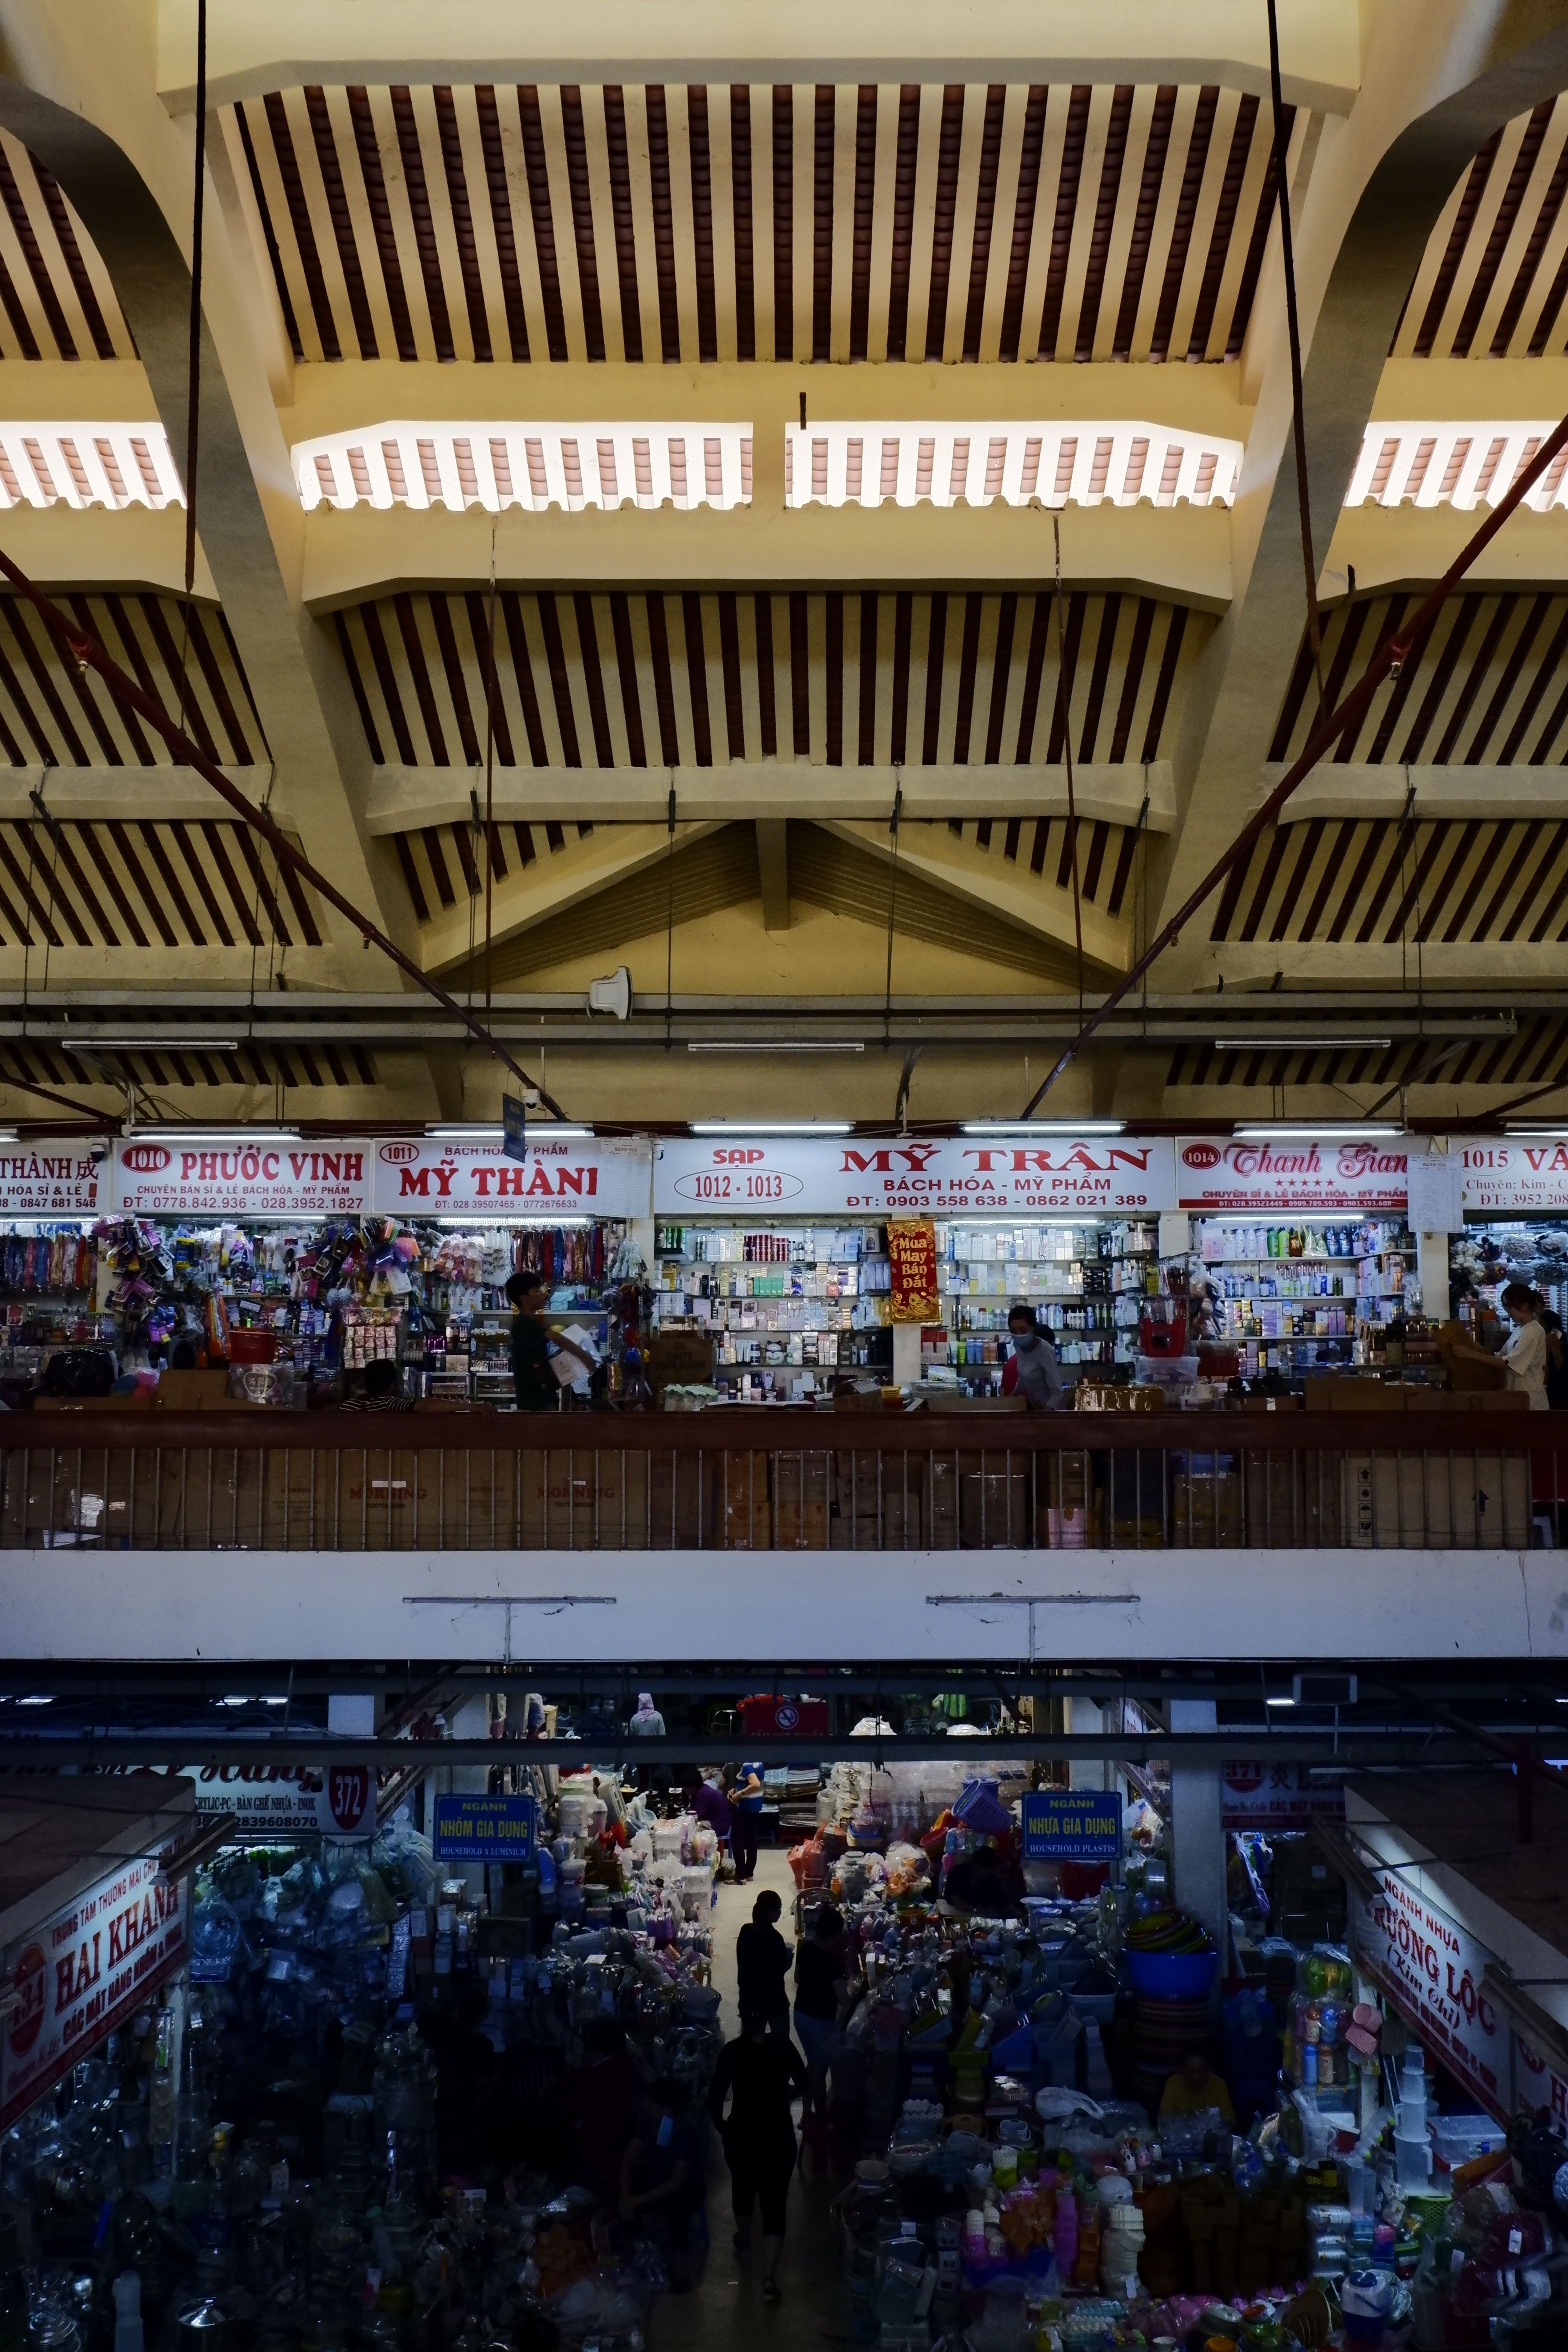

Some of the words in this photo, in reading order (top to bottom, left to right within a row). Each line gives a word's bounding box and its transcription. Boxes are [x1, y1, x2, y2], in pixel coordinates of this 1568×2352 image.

[388, 1147, 412, 1160] 1011
[445, 1145, 478, 1155] BÁCH
[534, 1142, 568, 1155] PHẨM
[129, 1150, 165, 1168] 1010
[180, 1144, 280, 1181] PHƯỚC
[288, 1153, 364, 1181] VINH
[713, 1149, 764, 1167] SẠP
[838, 1143, 942, 1172] MỸ
[962, 1142, 1153, 1171] TRÂN
[1188, 1152, 1216, 1163] 1014
[1223, 1142, 1322, 1178] Thanh
[1336, 1142, 1408, 1179] Gian
[1462, 1150, 1509, 1168] 1015
[0, 1151, 72, 1179] THÀNH
[399, 1159, 459, 1196] MỸ
[884, 1176, 941, 1191] BÁCH
[950, 1176, 995, 1191] HÓA
[1014, 1176, 1044, 1191] MỸ
[1052, 1172, 1111, 1191] PHẨM
[7, 1183, 32, 1195] HÓA
[37, 1183, 49, 1195] SỈ
[53, 1186, 62, 1195] &
[67, 1183, 82, 1195] LẺ
[137, 1184, 176, 1194] CHUYÊN
[180, 1184, 200, 1194] BÁN
[203, 1183, 212, 1194] SỈ
[227, 1183, 238, 1194] LẺ
[242, 1184, 269, 1194] BÁCH
[273, 1184, 292, 1194] HÓA
[303, 1185, 317, 1194] MỸ
[321, 1183, 350, 1194] PHẨM
[695, 1175, 730, 1197] 1012
[747, 1175, 782, 1197] 1013
[1466, 1179, 1517, 1192] Chuyên:
[1521, 1179, 1546, 1189] Kim
[1202, 1189, 1247, 1198] CHUYÊN
[1292, 1189, 1321, 1198] BÁCH
[1325, 1189, 1348, 1198] HÓA
[1357, 1189, 1373, 1198] MỸ
[1377, 1187, 1408, 1198] PHẨM
[20, 1198, 47, 1208] 0847
[51, 1198, 71, 1208] 681
[75, 1198, 96, 1208] 546
[123, 1197, 147, 1208] ĐT:
[153, 1198, 247, 1208] 0778.842.936
[261, 1198, 363, 1209] 028.3952.1827
[846, 1196, 879, 1206] ĐT:
[886, 1196, 930, 1206] 0903
[936, 1196, 968, 1206] 558
[975, 1196, 1007, 1206] 638
[1026, 1196, 1069, 1206] 0862
[1076, 1195, 1106, 1205] 021
[1115, 1195, 1147, 1205] 389
[1481, 1194, 1506, 1205] ĐT:
[1512, 1194, 1542, 1205] 3952
[899, 1238, 927, 1249] Mua
[900, 1250, 927, 1263] May
[902, 1262, 927, 1275] Bán
[902, 1274, 927, 1289] Đắt
[334, 1775, 361, 1816] 372
[237, 1795, 252, 1810] BÀN
[254, 1794, 269, 1810] GHẾ
[271, 1795, 292, 1813] NHỰA
[298, 1798, 316, 1810] INOX
[462, 1802, 507, 1811] NGÀNH
[1050, 1798, 1094, 1808] NGÀNH
[236, 1817, 318, 1827] 2839608070
[1029, 1816, 1060, 1838] NHỰA
[1063, 1817, 1082, 1835] GIA
[1085, 1817, 1116, 1838] DỤNG
[440, 1817, 473, 1837] NHÔM
[476, 1820, 494, 1837] GIA
[498, 1821, 528, 1841] DỤNG
[491, 1847, 526, 1856] LUMINIUM
[1384, 1876, 1422, 1922] NGÀNH
[1426, 1915, 1460, 1956] NHỰA
[52, 1913, 78, 1948] TRUNG
[80, 1900, 96, 1927] TÂM
